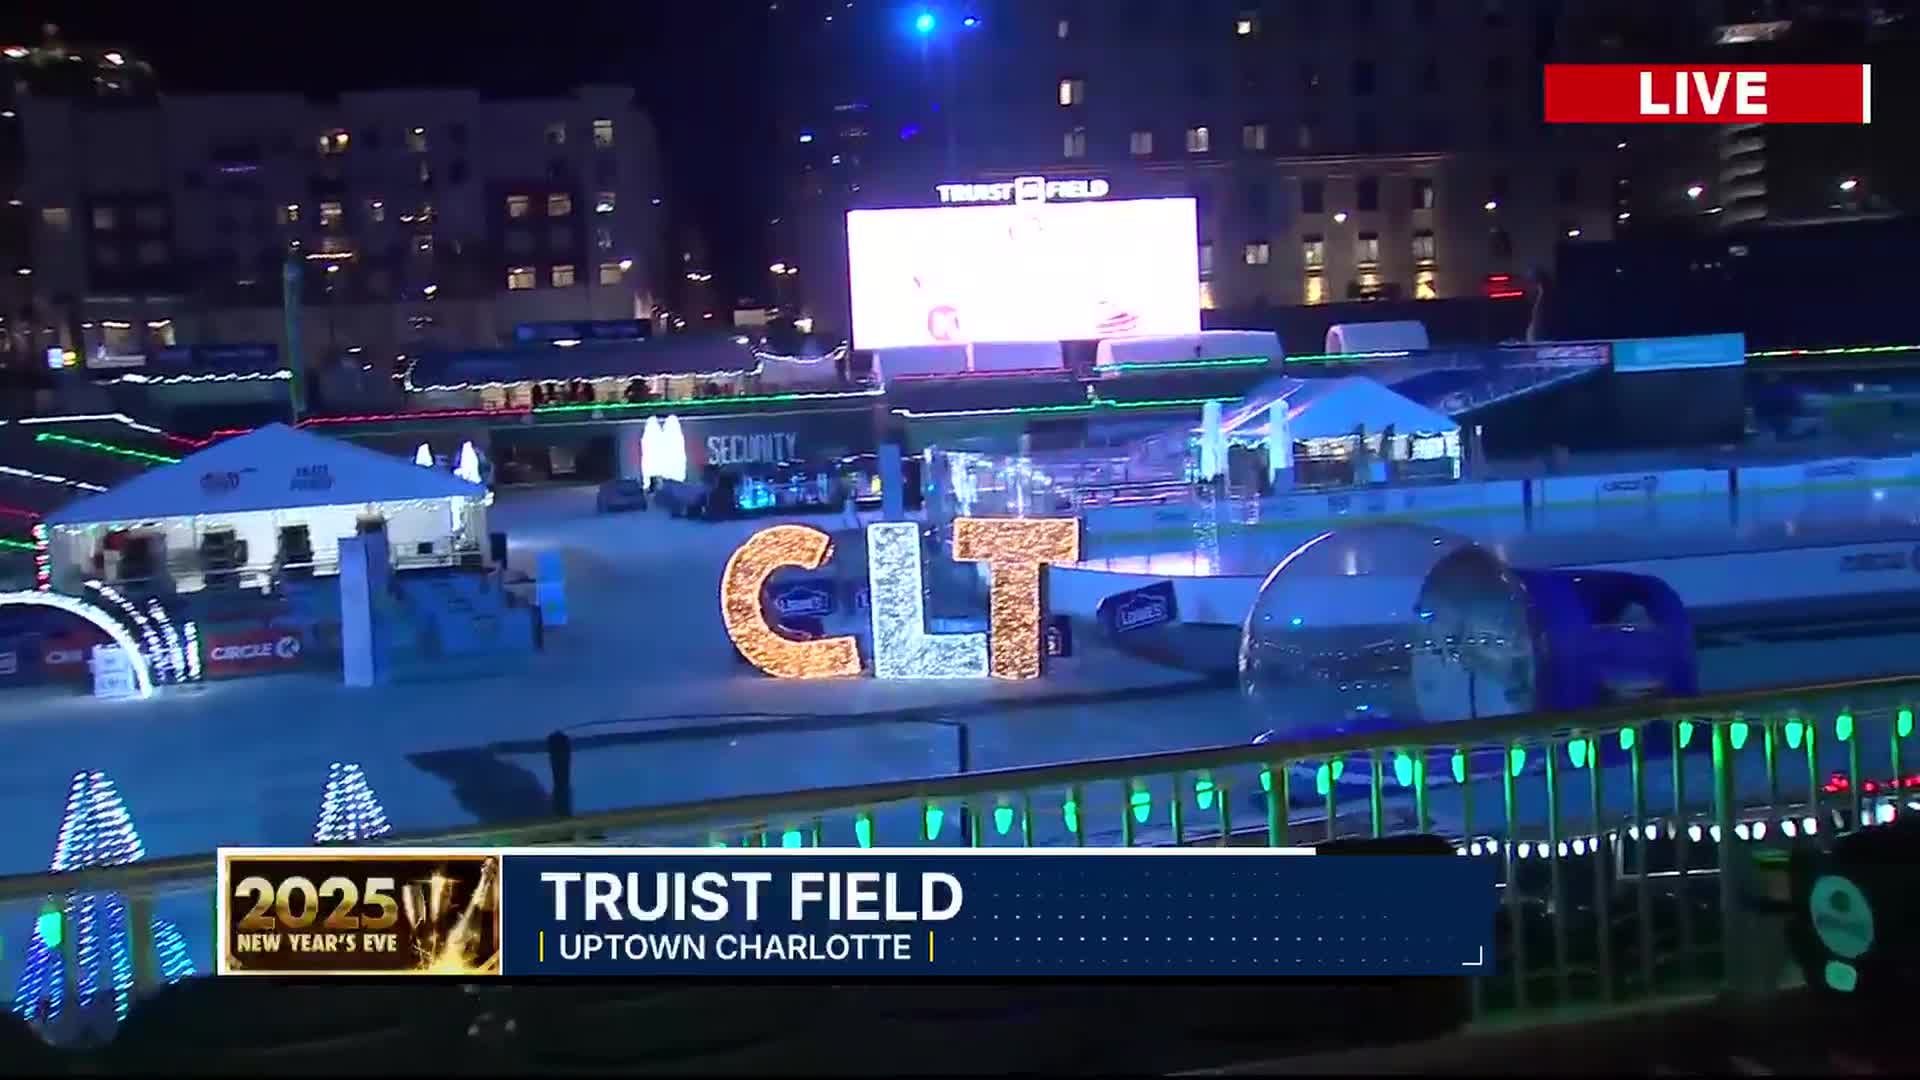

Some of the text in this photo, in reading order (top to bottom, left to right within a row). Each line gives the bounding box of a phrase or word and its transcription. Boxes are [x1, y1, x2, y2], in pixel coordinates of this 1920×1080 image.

[935, 178, 1110, 203] TRUIST FIELD
[706, 432, 798, 465] SECURITY
[720, 517, 1082, 680] CLT
[210, 642, 273, 660] CIRCLE
